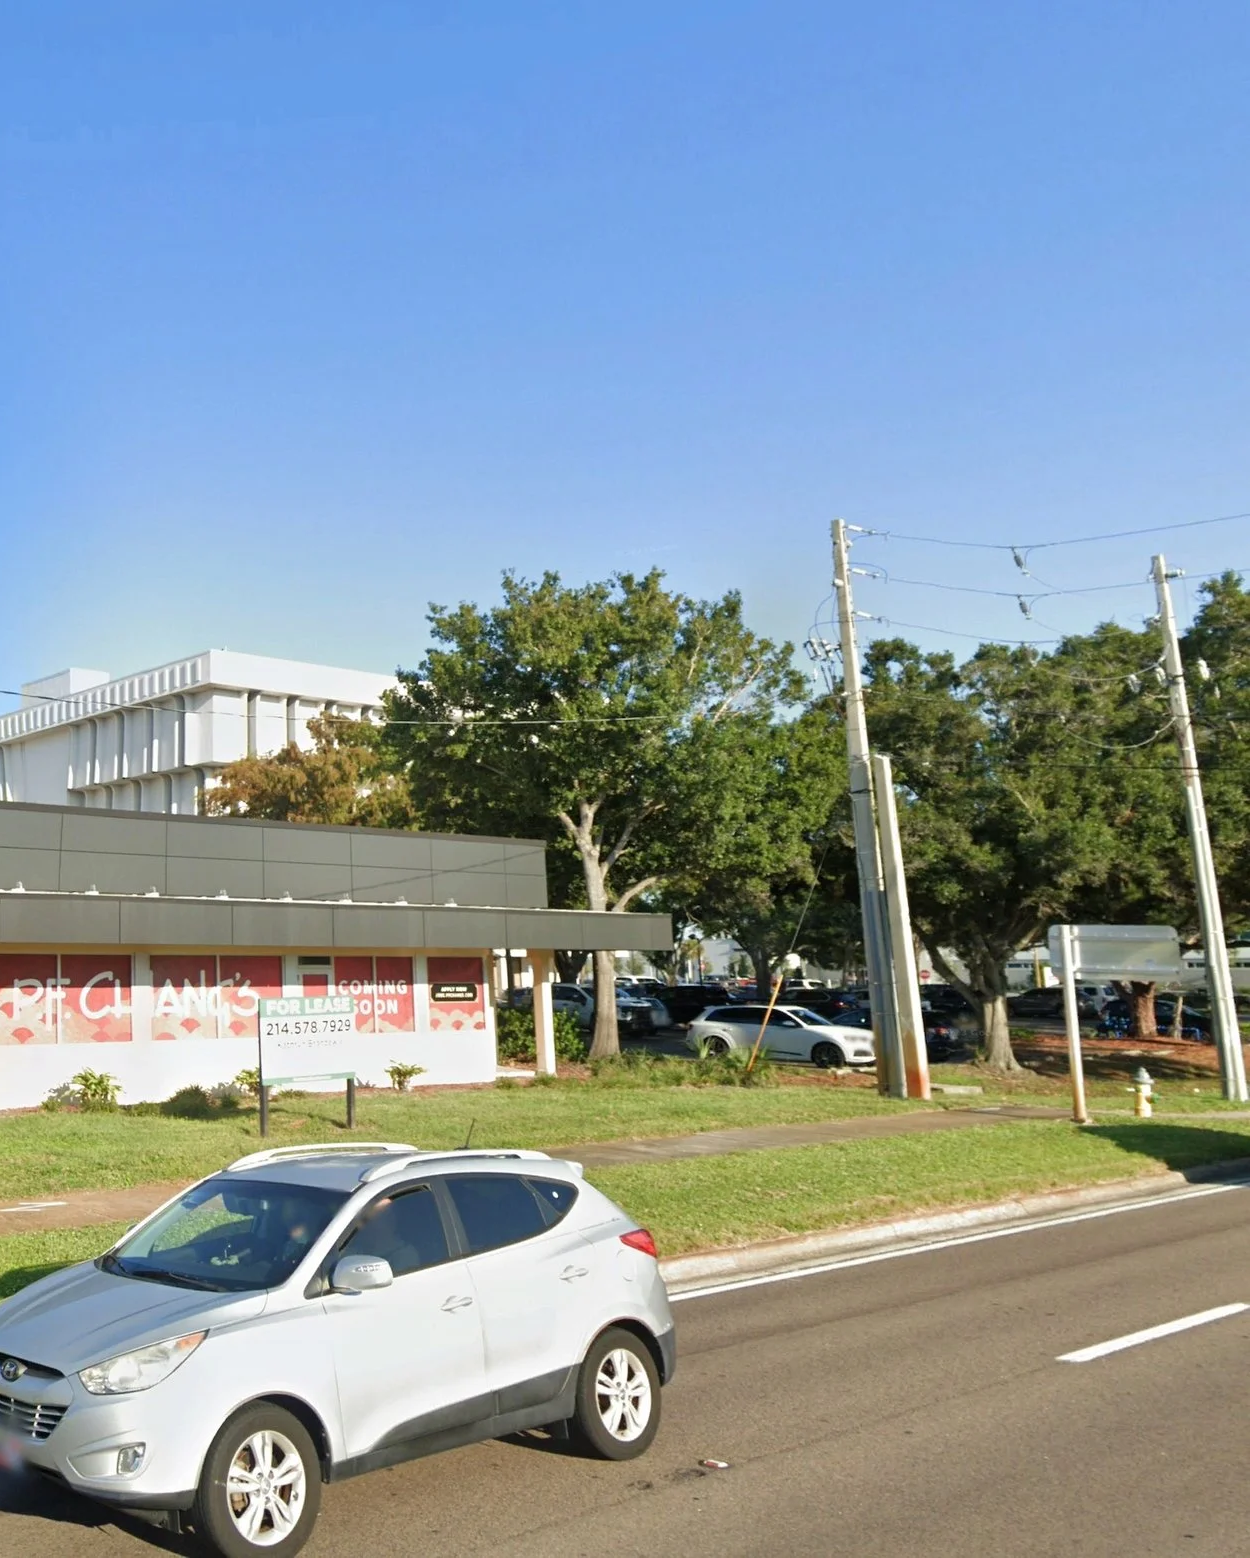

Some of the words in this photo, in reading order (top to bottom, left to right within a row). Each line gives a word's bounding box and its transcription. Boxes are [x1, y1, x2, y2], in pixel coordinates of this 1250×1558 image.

[338, 979, 408, 995] COMING
[266, 999, 301, 1016] FOR
[305, 996, 350, 1014] LEASE
[266, 1018, 351, 1036] 214.578.7929
